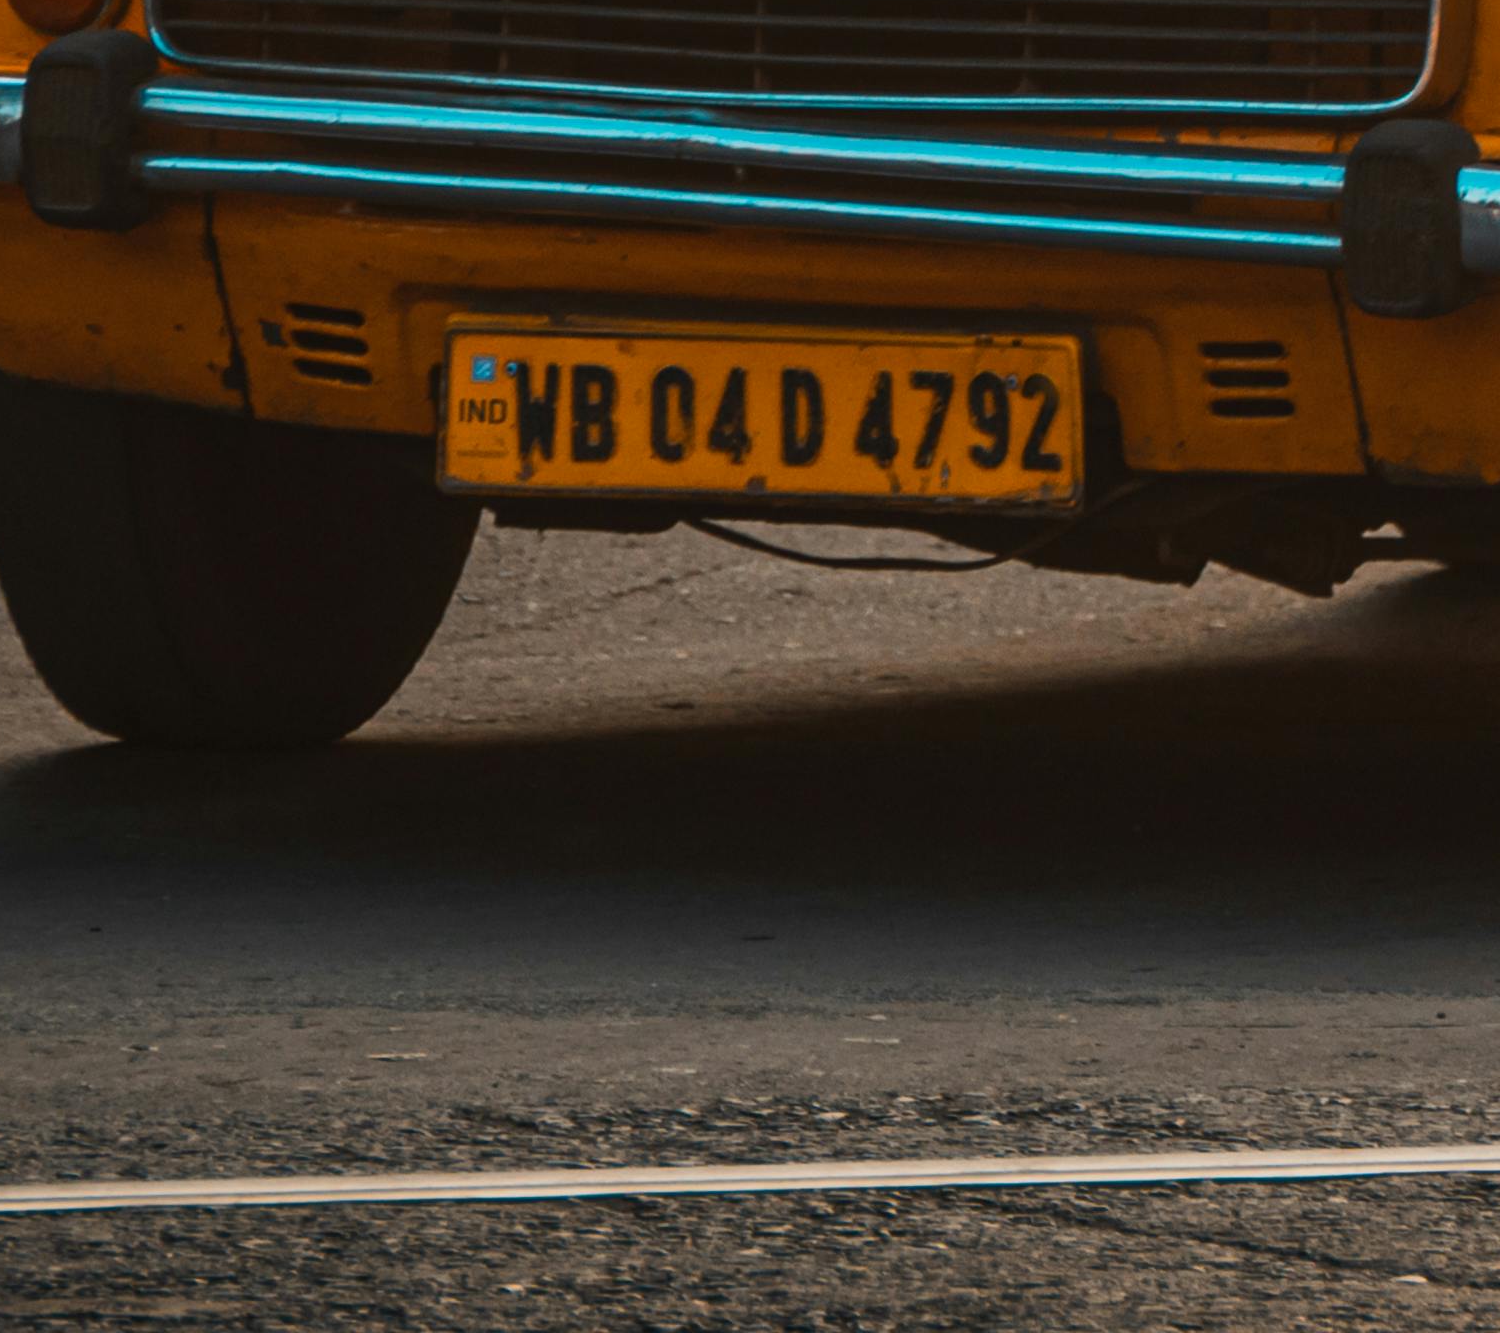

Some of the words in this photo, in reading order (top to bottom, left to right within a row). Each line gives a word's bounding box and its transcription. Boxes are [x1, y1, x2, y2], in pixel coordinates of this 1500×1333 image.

[458, 398, 508, 426] IND
[514, 361, 618, 464] WB
[650, 365, 751, 464] 04
[780, 368, 825, 468] D
[855, 371, 1063, 472] 4792
